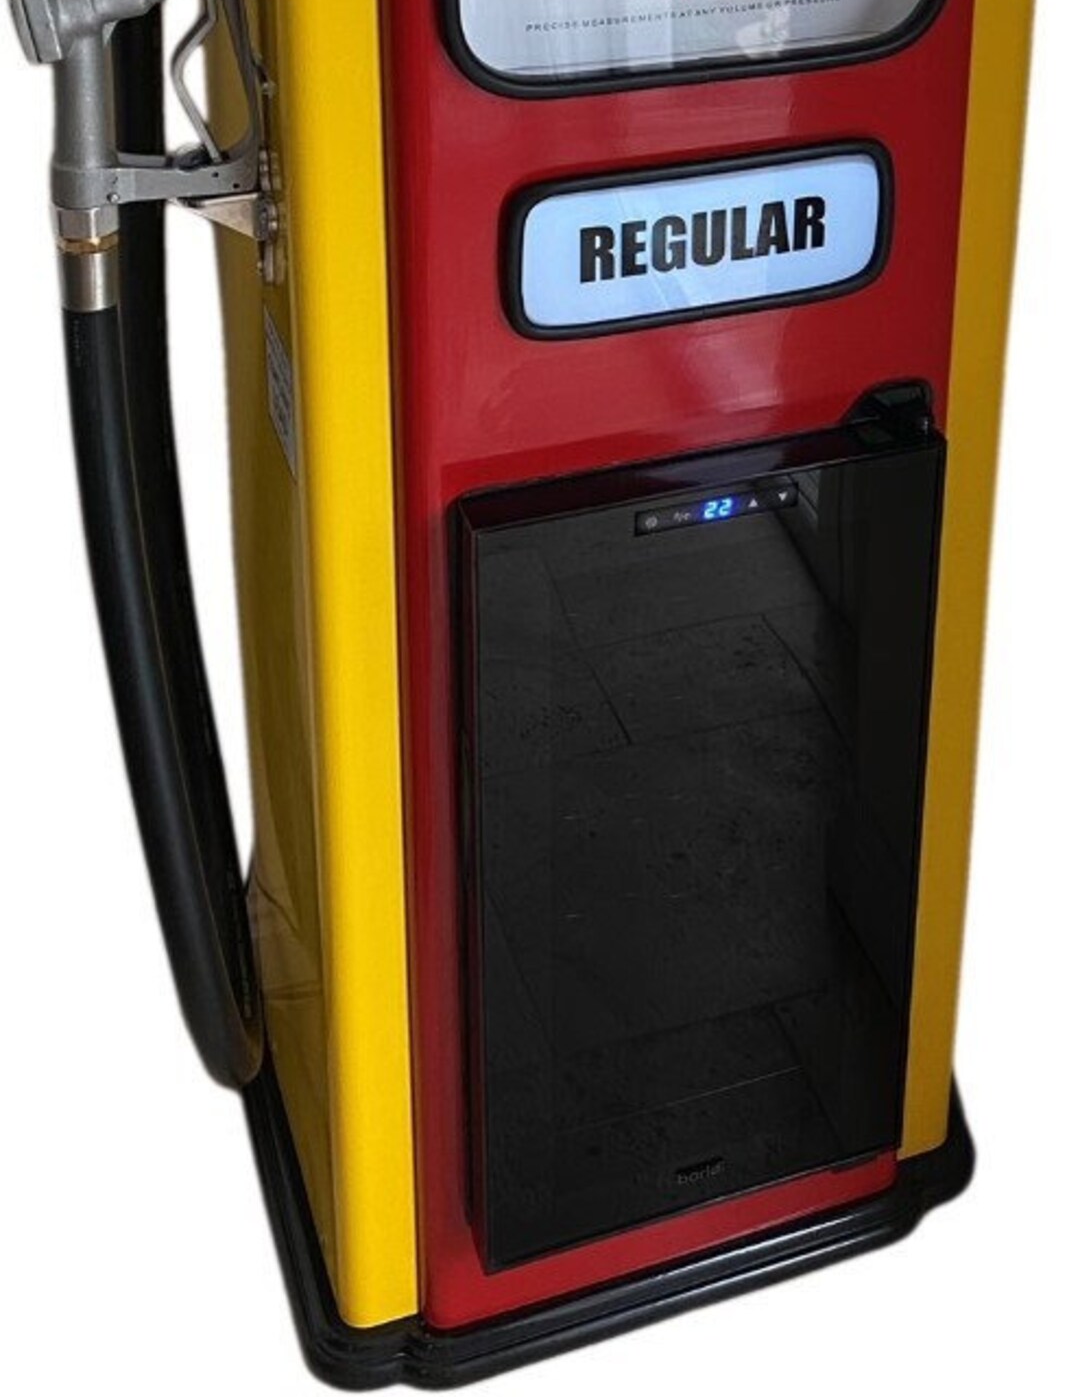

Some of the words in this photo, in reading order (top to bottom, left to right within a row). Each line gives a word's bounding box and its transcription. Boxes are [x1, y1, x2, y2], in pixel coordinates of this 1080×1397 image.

[719, 2, 763, 14] VOLUME
[580, 196, 826, 283] REGULAR
[703, 497, 733, 520] 22
